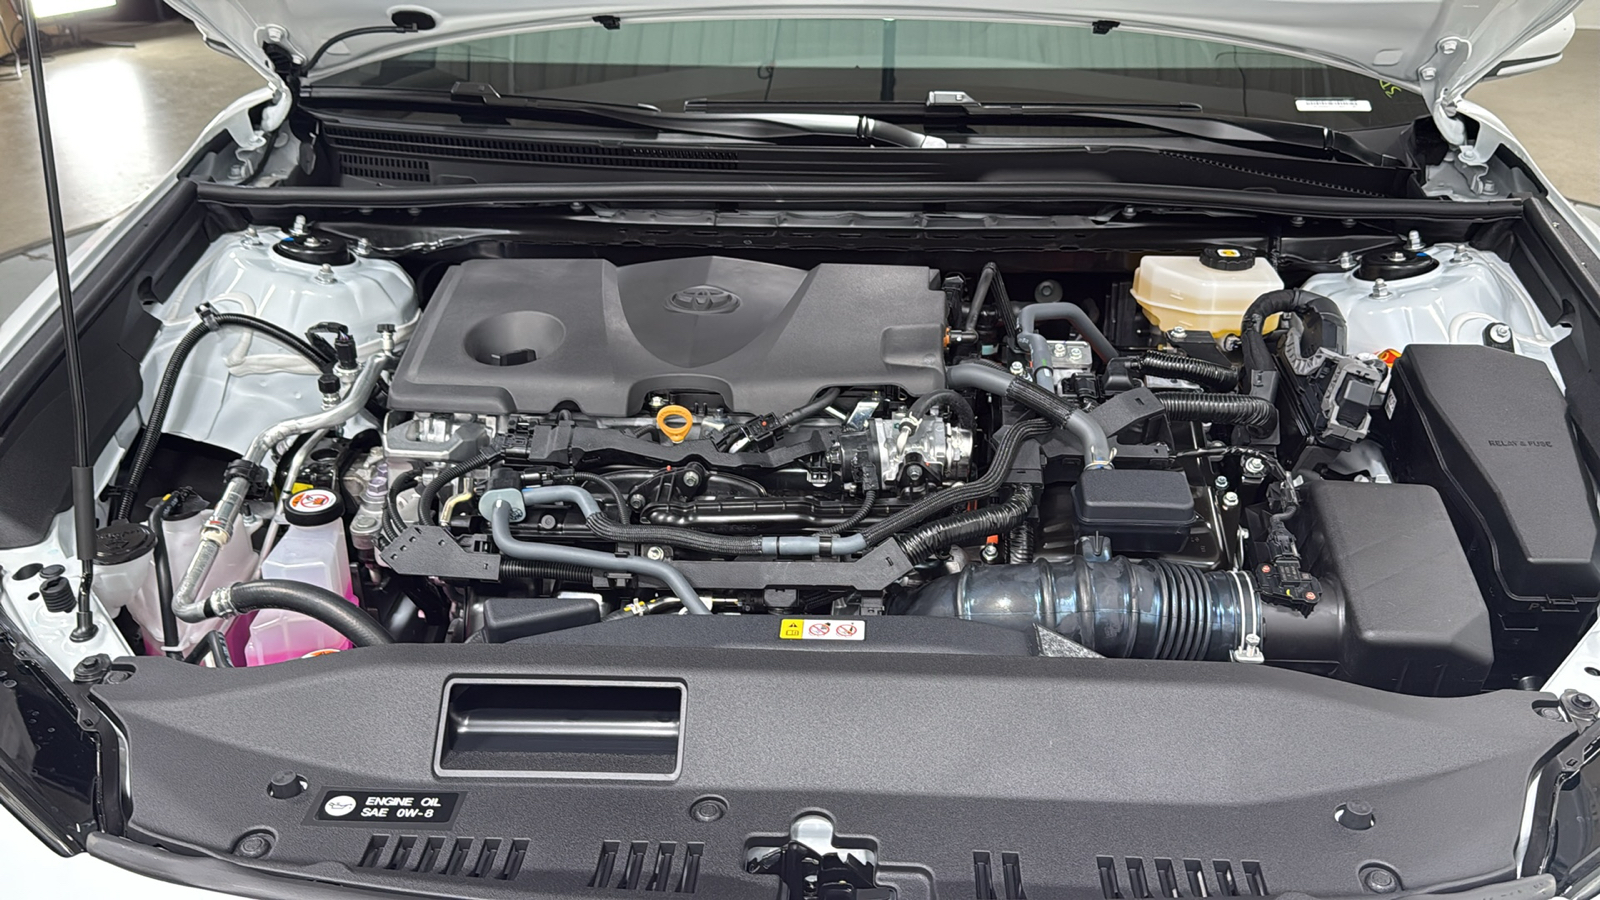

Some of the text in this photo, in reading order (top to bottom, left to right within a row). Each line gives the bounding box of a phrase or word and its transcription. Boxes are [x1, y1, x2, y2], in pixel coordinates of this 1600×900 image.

[1528, 440, 1553, 448] FUSE
[365, 796, 442, 807] ENGINE OIL
[360, 808, 434, 818] SAE 0W-8
